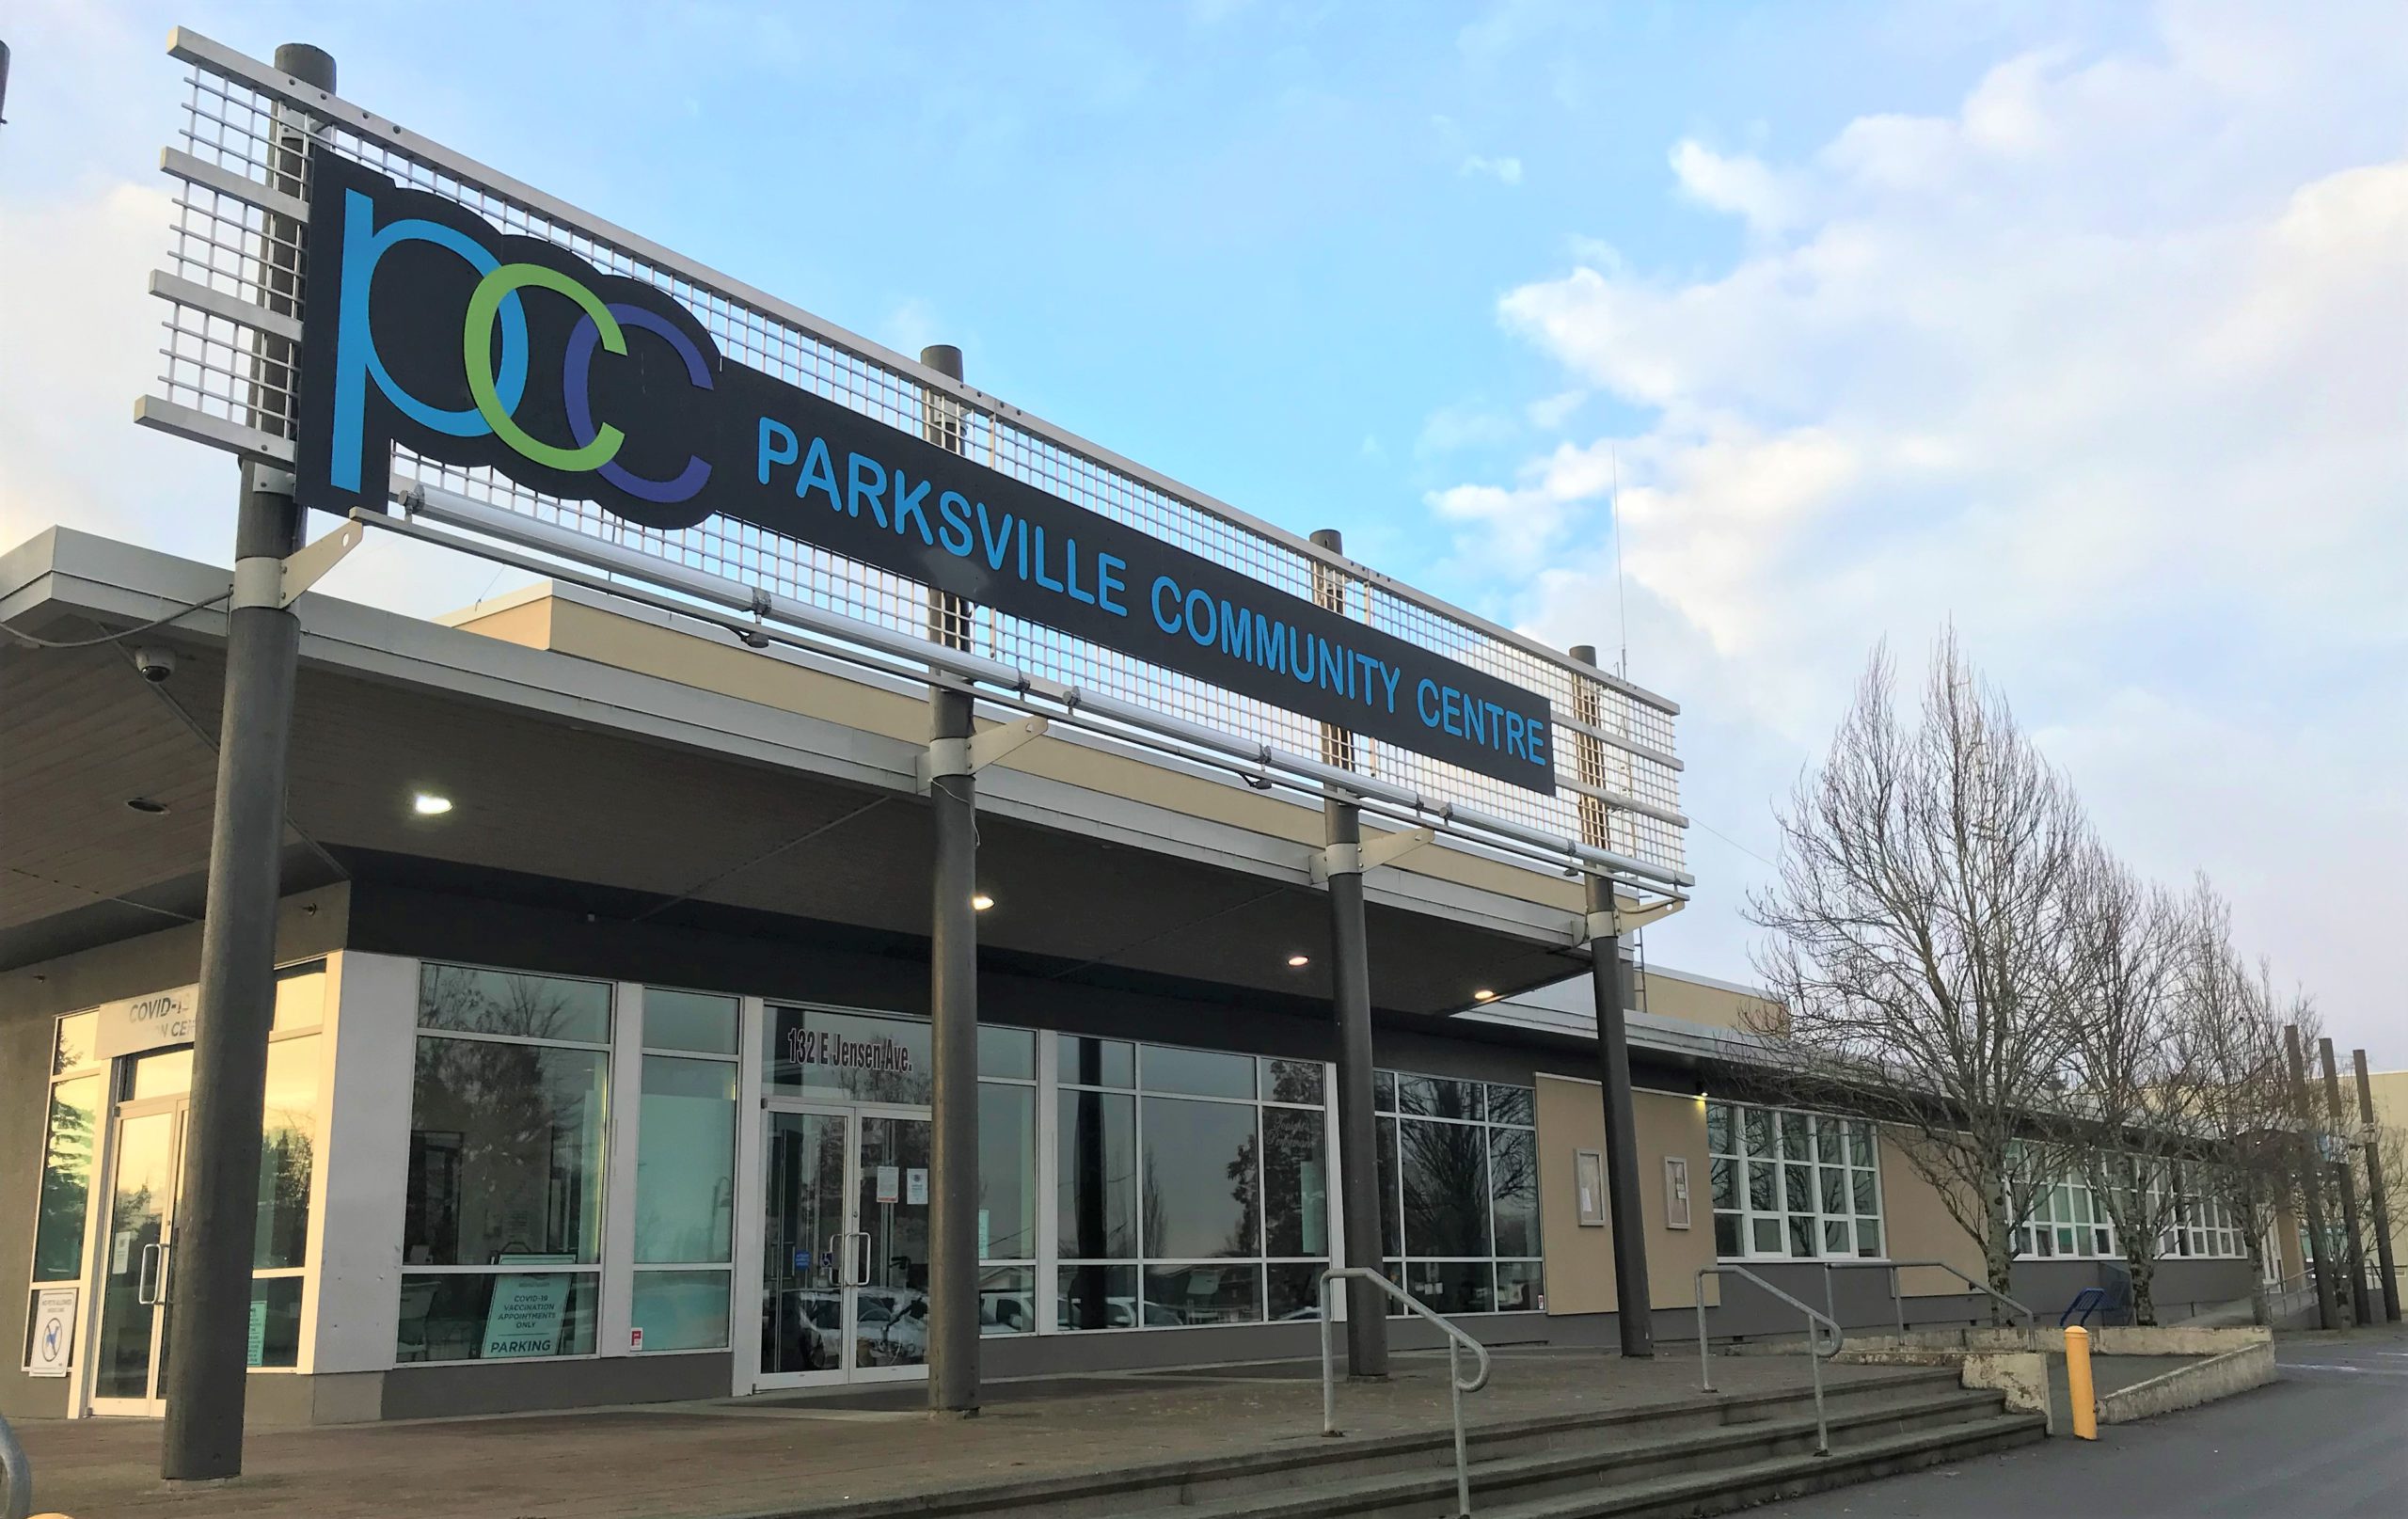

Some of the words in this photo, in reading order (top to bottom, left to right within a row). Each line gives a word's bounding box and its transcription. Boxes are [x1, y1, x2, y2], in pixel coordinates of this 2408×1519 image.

[756, 416, 1128, 617] PARKSVILLE
[1150, 575, 1401, 713] COMMUNITY
[1417, 677, 1547, 766] CENTRE
[129, 995, 189, 1023] COVID-1
[788, 1028, 816, 1065] 132
[819, 1032, 830, 1066] E
[832, 1034, 882, 1069] Jensen
[884, 1038, 912, 1072] Ave.
[498, 1312, 557, 1321] APPOINTMENTS
[490, 1339, 551, 1353] PARKING
